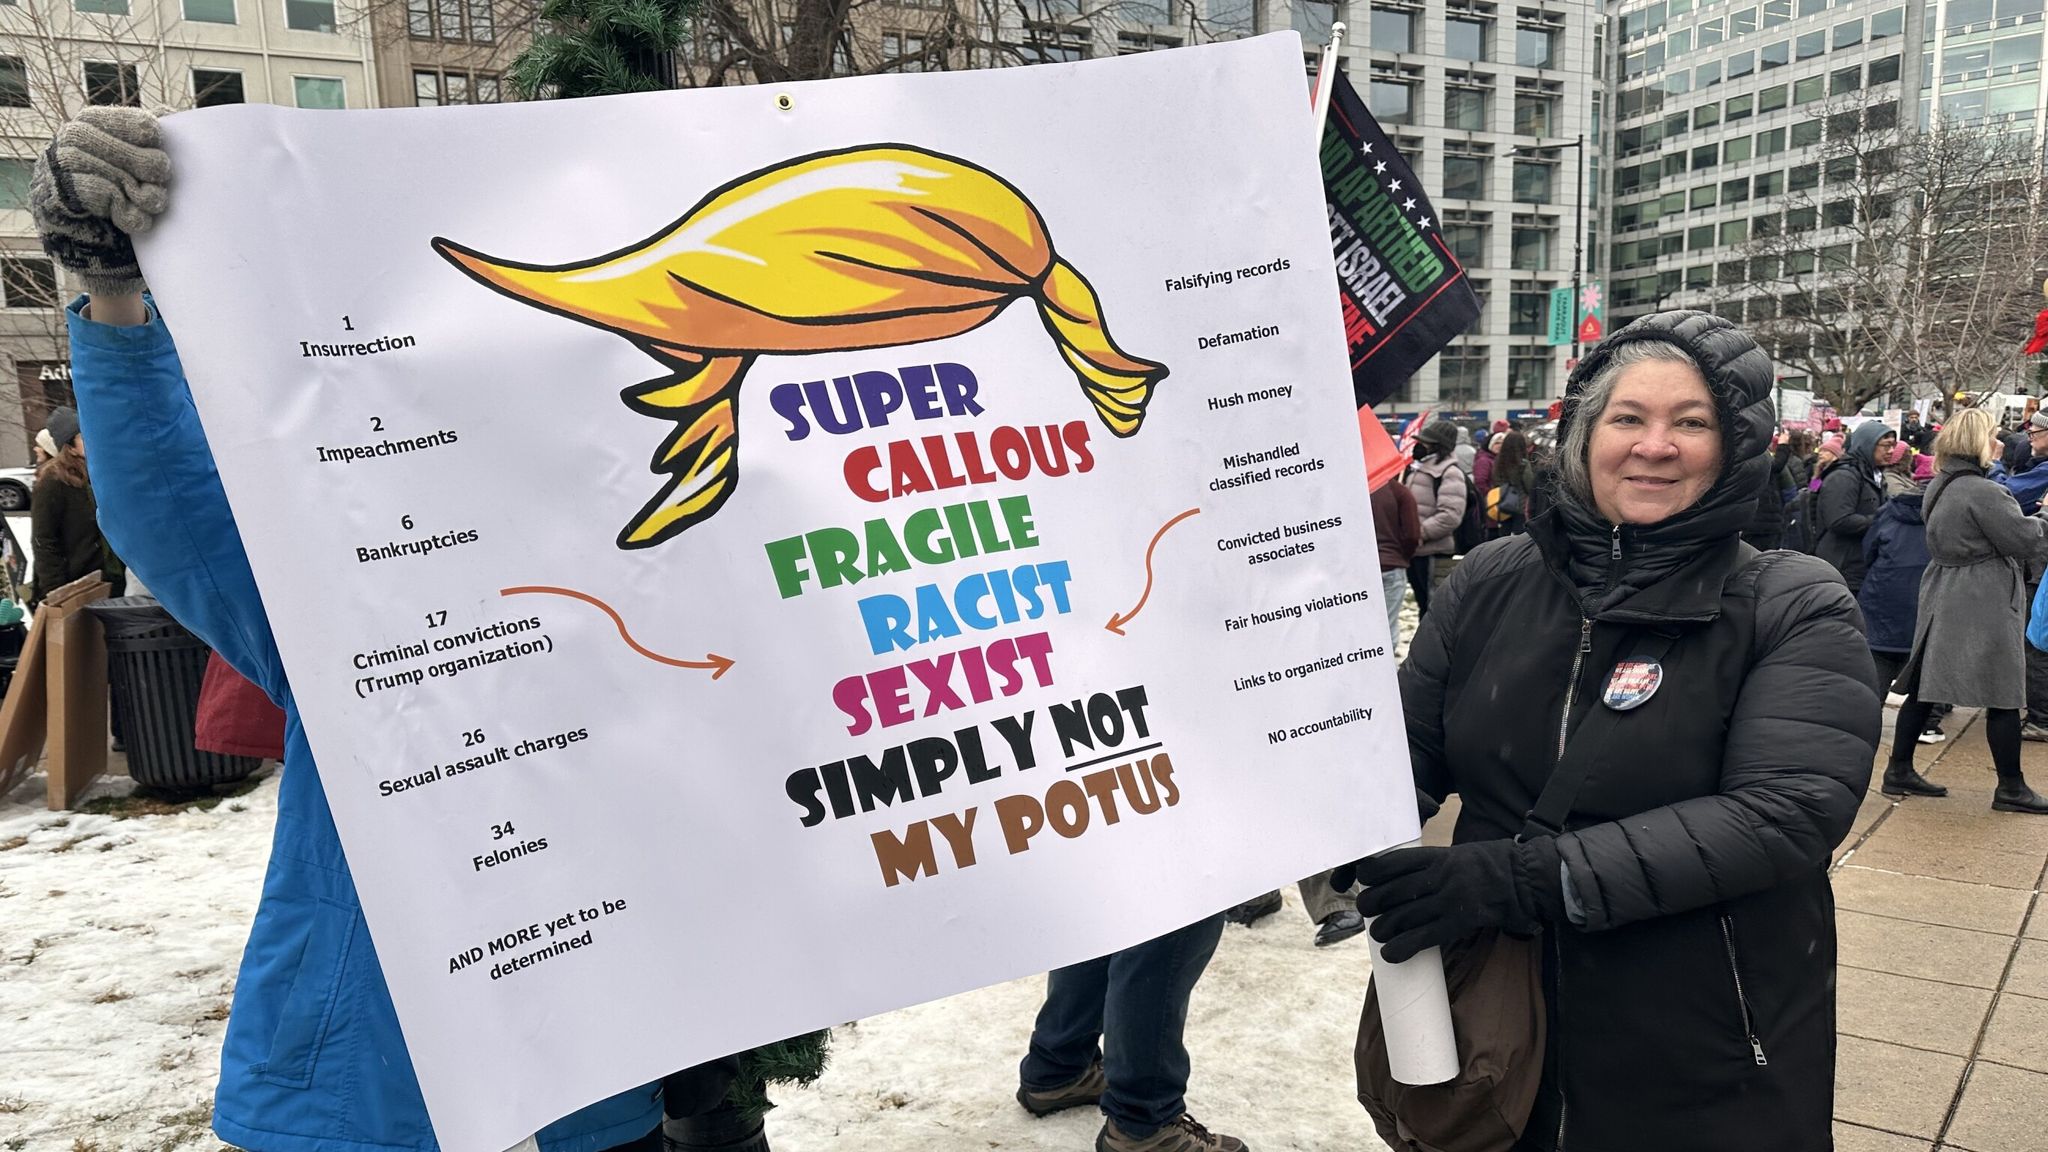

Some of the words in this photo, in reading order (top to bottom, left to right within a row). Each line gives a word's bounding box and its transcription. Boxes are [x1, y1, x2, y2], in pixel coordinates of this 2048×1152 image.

[1331, 163, 1444, 293] APARTHEID
[1165, 271, 1233, 292] Falsifying
[1236, 257, 1291, 280] records
[1334, 238, 1406, 327] ISRAEL
[342, 315, 355, 331] 1
[1198, 325, 1280, 350] Defamation
[300, 335, 416, 358] Insurrection
[769, 362, 986, 442] SUPER
[1207, 392, 1244, 411] Hush
[1248, 384, 1293, 403] money
[369, 416, 385, 433] 2
[316, 429, 458, 464] Impeachments
[843, 420, 1095, 503] CALLOUS
[1222, 442, 1300, 470] Mishandled
[1209, 467, 1272, 492] classified
[1274, 458, 1325, 479] records
[401, 514, 414, 531] 6
[1217, 527, 1281, 551] Convicted
[1283, 516, 1343, 538] business
[355, 529, 479, 563] Bankruptcies
[764, 494, 1040, 600] FRAGILE
[1248, 541, 1316, 566] associates
[425, 609, 448, 629] 17
[857, 559, 1072, 656] RACIST
[1225, 617, 1249, 632] Fair
[1251, 605, 1301, 625] housing
[1305, 590, 1369, 613] violations
[353, 639, 430, 670] Criminal
[433, 616, 541, 651] convictions
[355, 668, 424, 699] (Trump
[428, 635, 554, 677] organization)
[832, 631, 1054, 737] SEXIST
[1233, 675, 1266, 692] Links
[1268, 671, 1282, 683] to
[1284, 652, 1344, 679] organized
[1346, 646, 1385, 663] crime
[461, 728, 486, 748] 26
[1267, 729, 1287, 745] NO
[1289, 707, 1373, 739] accountability
[378, 764, 442, 797] Sexual
[444, 746, 511, 778] assault
[513, 728, 589, 757] charges
[785, 710, 1036, 828] SIMPLY
[1048, 684, 1150, 759] NOT
[490, 820, 516, 841] 34
[869, 806, 978, 888] MY
[994, 752, 1180, 855] POTUS
[472, 837, 549, 872] Felonies
[449, 946, 484, 974] AND
[487, 923, 542, 956] MORE
[544, 912, 576, 937] yet
[578, 908, 599, 923] to
[602, 899, 627, 916] be
[489, 929, 593, 981] determined
